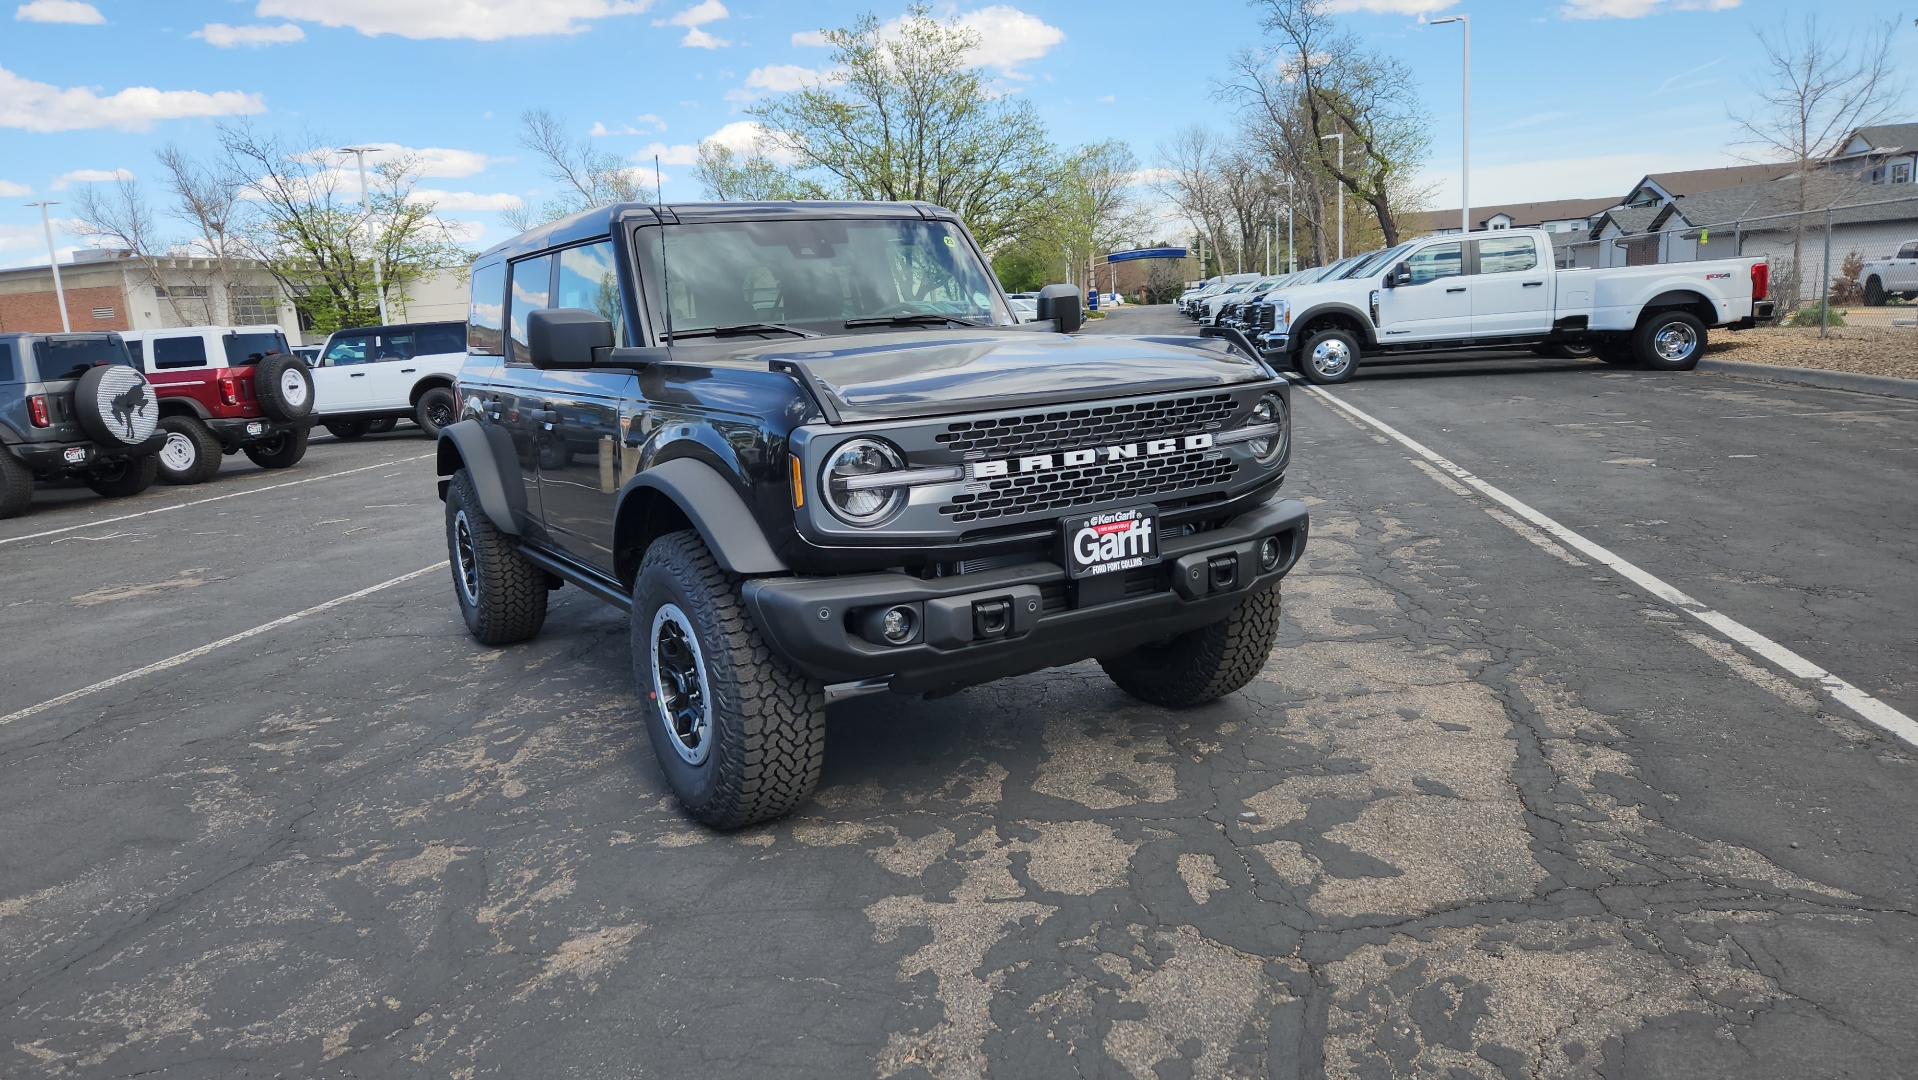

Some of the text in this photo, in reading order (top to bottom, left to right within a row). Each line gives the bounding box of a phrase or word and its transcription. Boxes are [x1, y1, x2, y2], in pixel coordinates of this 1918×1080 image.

[63, 448, 86, 460] Garff
[972, 433, 1213, 478] BRONCO
[1098, 510, 1136, 524] Ken Garff
[1073, 518, 1152, 565] Garff
[1092, 557, 1143, 575] FORD FORT COLLINS
